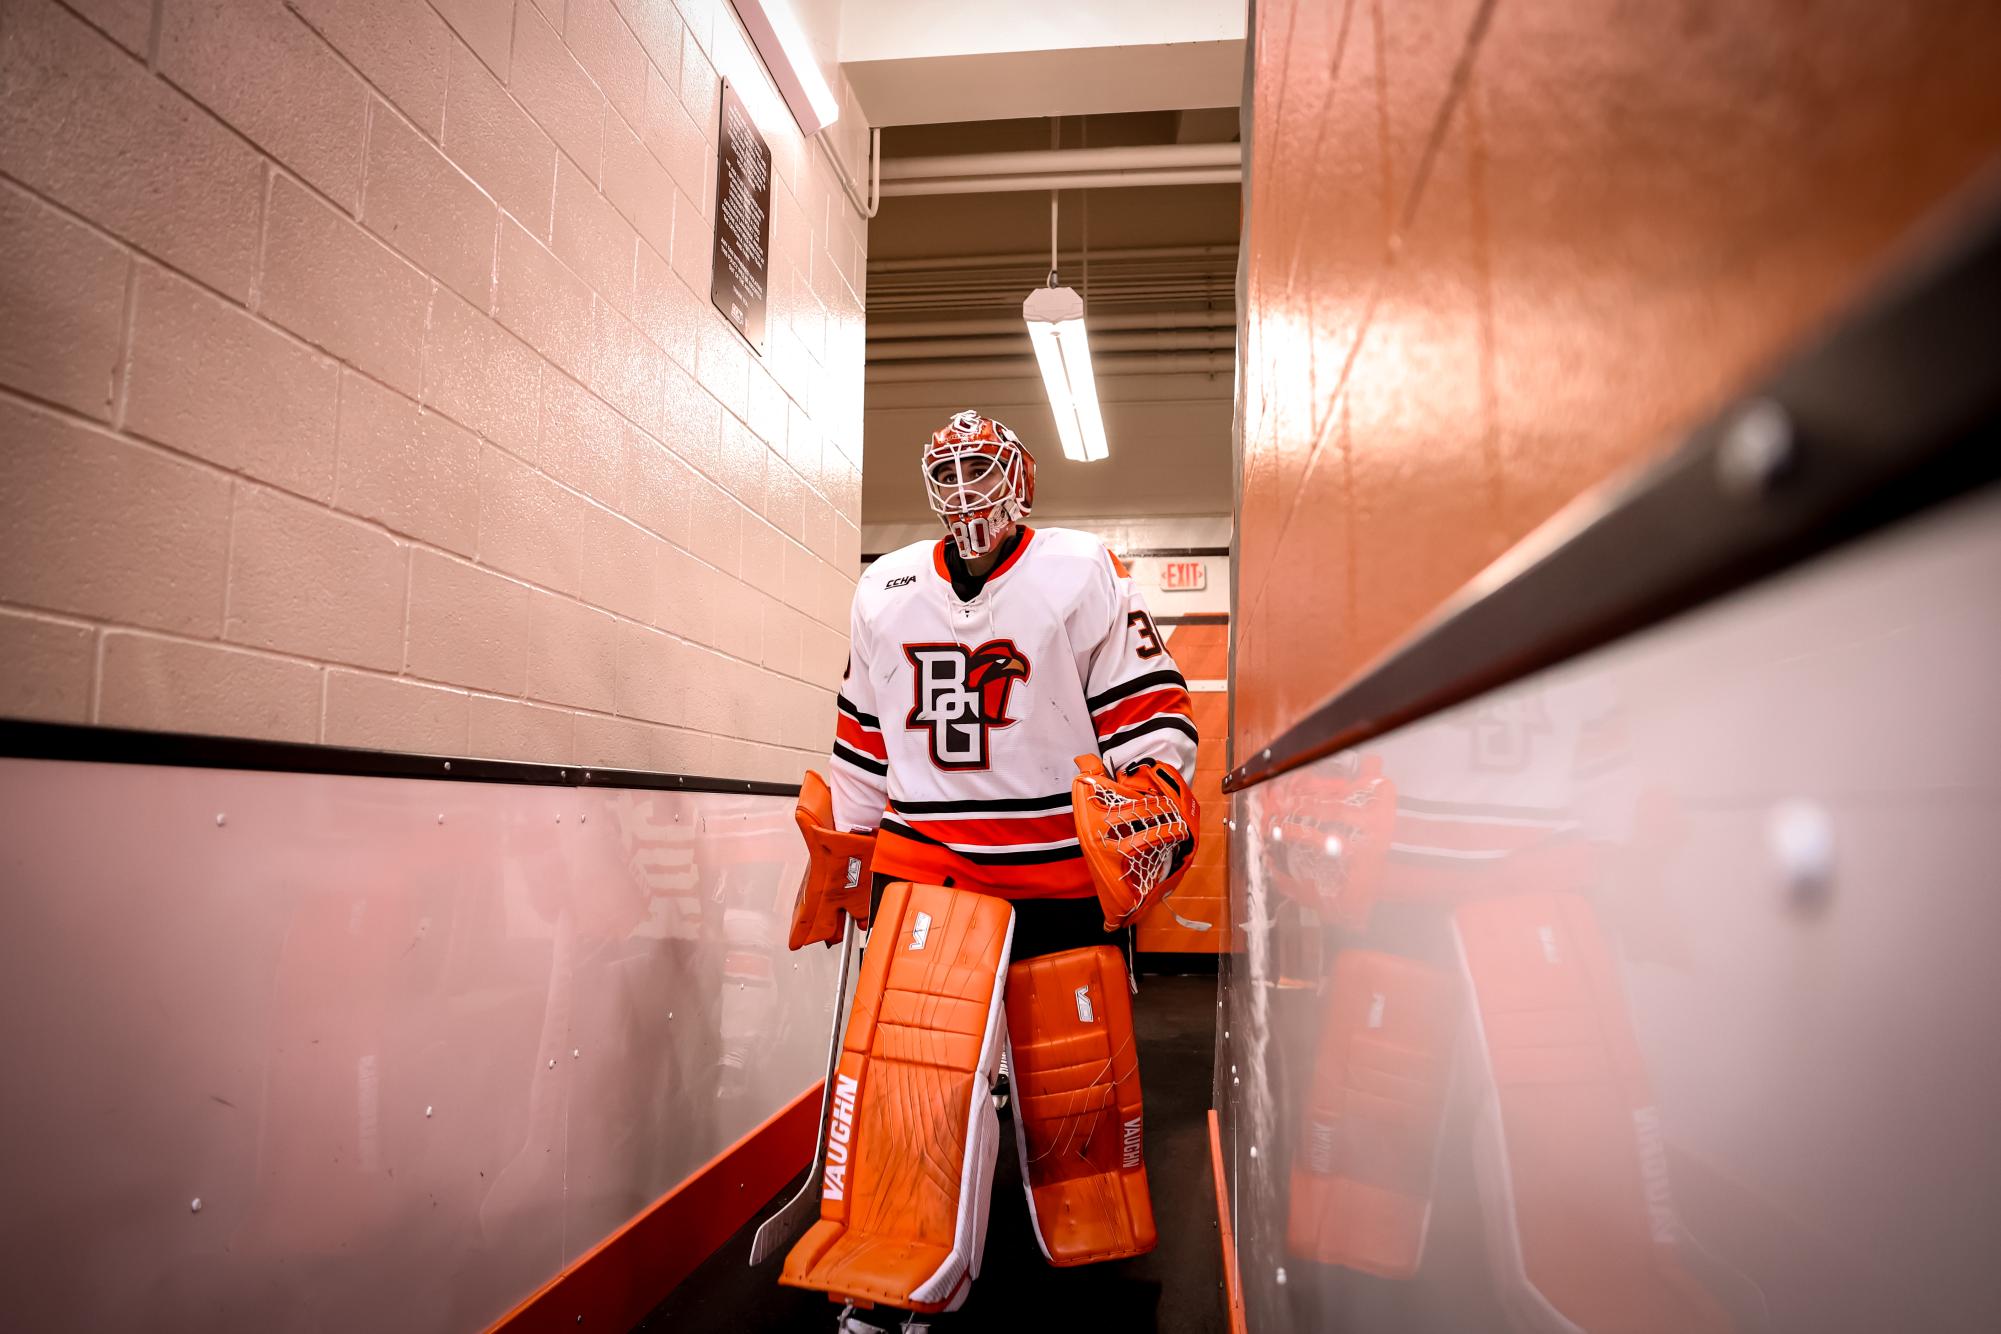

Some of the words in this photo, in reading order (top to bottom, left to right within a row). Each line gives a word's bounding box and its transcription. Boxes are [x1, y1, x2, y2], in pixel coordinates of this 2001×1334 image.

[885, 576, 917, 588] CCHA
[1167, 562, 1199, 588] EXIT
[911, 648, 983, 765] BG
[823, 1074, 858, 1200] VAUGHN
[1123, 1117, 1140, 1168] VAUGHN
